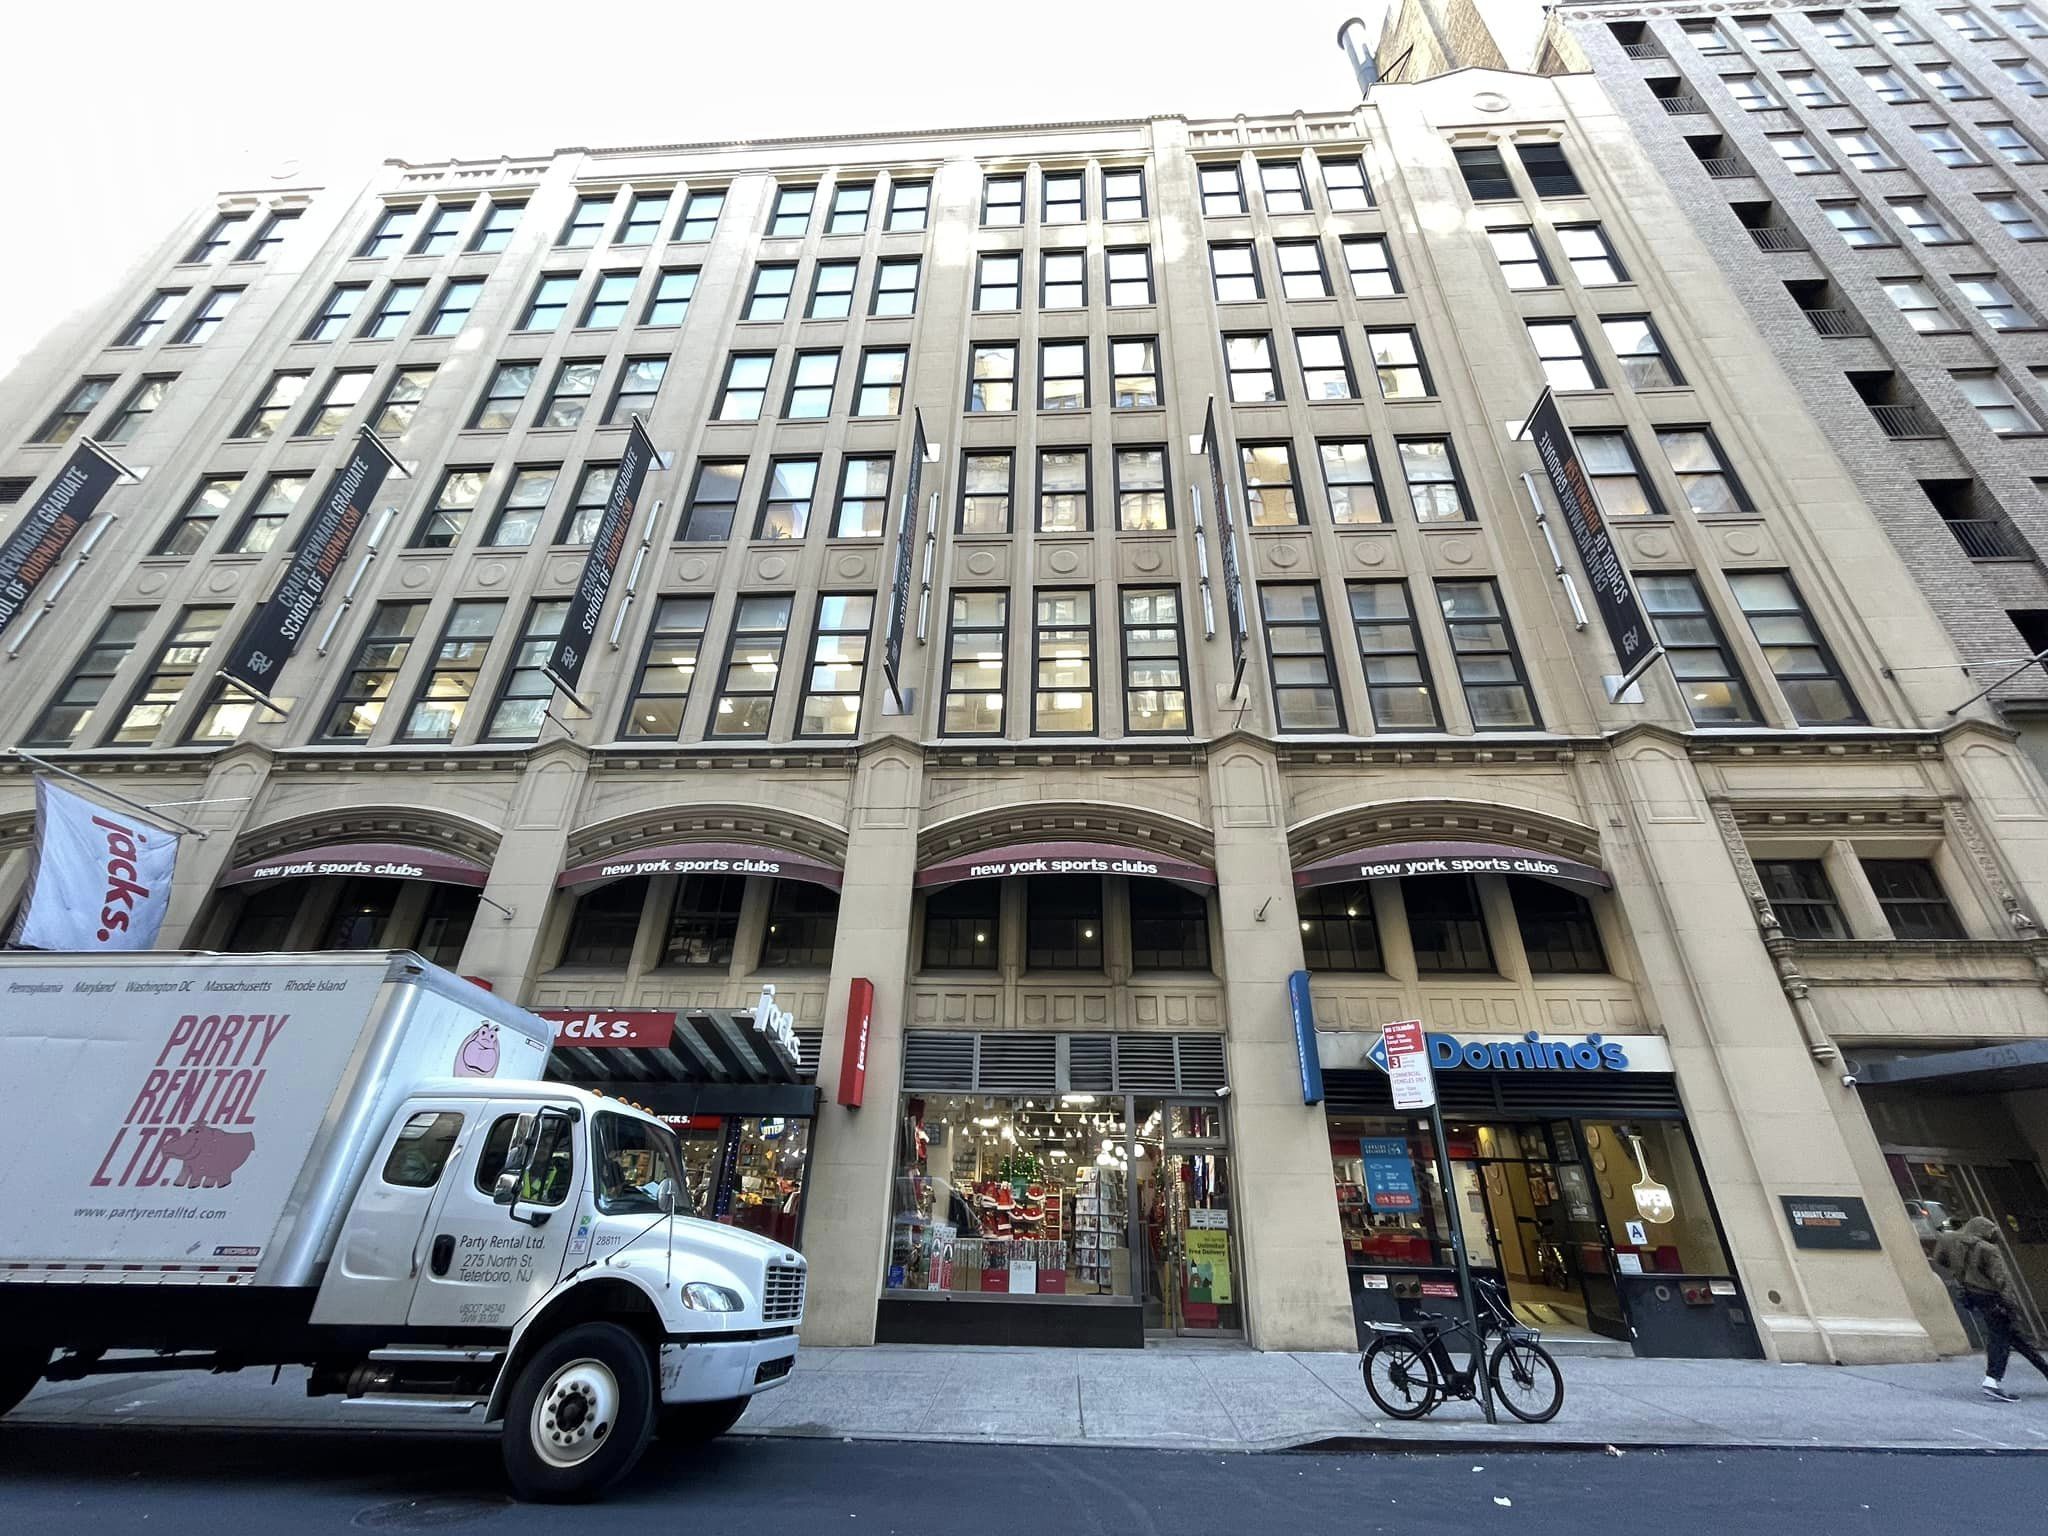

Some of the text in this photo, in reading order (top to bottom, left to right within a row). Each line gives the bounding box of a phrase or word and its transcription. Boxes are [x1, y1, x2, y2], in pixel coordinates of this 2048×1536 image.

[0, 465, 88, 578] NEWMARK GRADUATE
[1539, 430, 1609, 593] CRAIG NEWMARK GRADUATE
[277, 456, 369, 608] CRAIG NEWMARK GRADUATE
[580, 446, 639, 601] CRAIG NEWMARK GRADUATE
[1563, 455, 1628, 604] SCHOOL OF JOURNALISM
[6, 579, 28, 599] OF
[19, 513, 80, 585] JOURNALISM
[582, 496, 633, 635] SCHOOL OF JOURNALISM
[280, 505, 361, 640] SCHOOL OF JOURNALISM
[254, 861, 424, 878] new york sports clubs
[601, 859, 780, 876] new york sports clubs
[970, 859, 1158, 876] new york sports clubs
[1361, 858, 1559, 876] new york sports clubs
[92, 816, 150, 942] jacks.
[72, 981, 117, 996] Maryland
[125, 980, 196, 995] Washington DC
[204, 980, 272, 992] Massachusetts
[285, 980, 348, 992] Rhode Island
[546, 1014, 637, 1038] acks.
[155, 1014, 291, 1067] PARTY
[1425, 1031, 1629, 1071] Domino's
[124, 1069, 267, 1124] RENTAL
[73, 1206, 227, 1221] www.partyrentalltd.com
[1632, 1225, 1642, 1238] A
[460, 1235, 546, 1251] Party Rental Ltd.
[463, 1254, 485, 1267] 275
[487, 1254, 517, 1267] North
[460, 1268, 534, 1283] Teterboro, NJ
